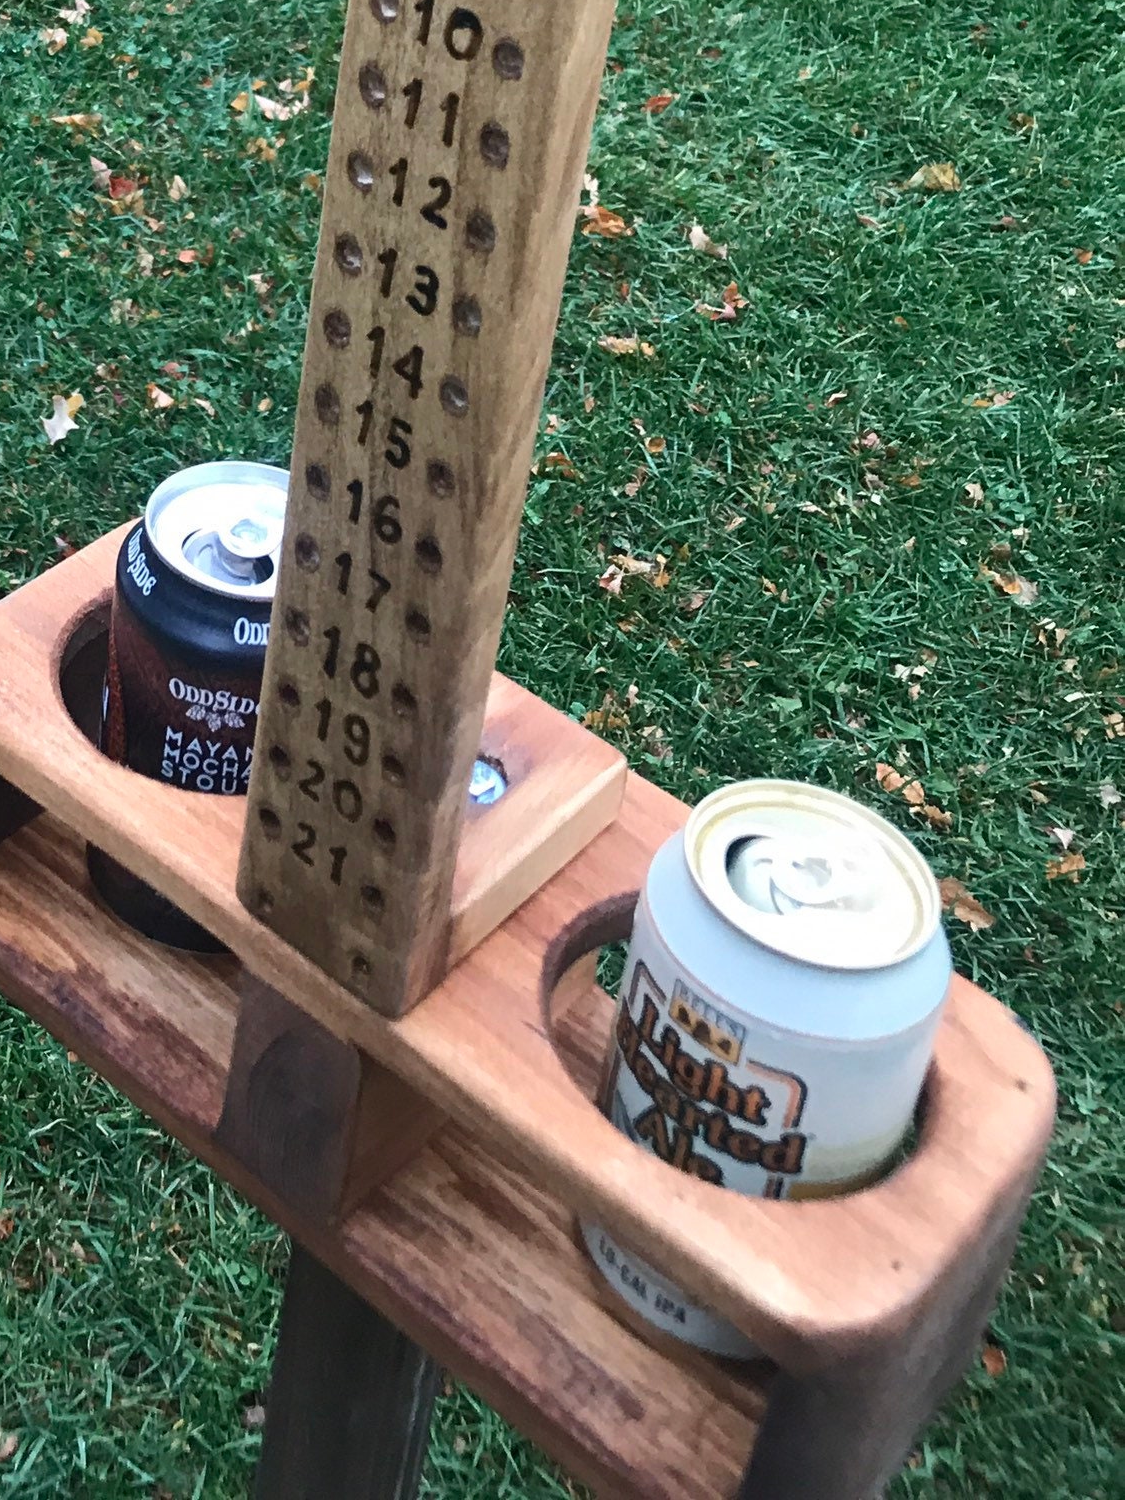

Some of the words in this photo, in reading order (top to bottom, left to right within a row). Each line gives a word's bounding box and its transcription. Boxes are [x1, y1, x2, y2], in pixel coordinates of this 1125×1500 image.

[401, 77, 460, 148] 11
[388, 157, 452, 231] 12
[378, 247, 440, 317] 13
[366, 326, 424, 400] 14
[355, 400, 412, 470] 15
[346, 479, 403, 544] 16
[335, 552, 391, 613] 17
[323, 625, 381, 699] 18
[315, 698, 371, 767] 19
[160, 759, 249, 795] STOU
[298, 759, 363, 824] 20
[291, 821, 348, 886] 21
[637, 993, 772, 1127] Light
